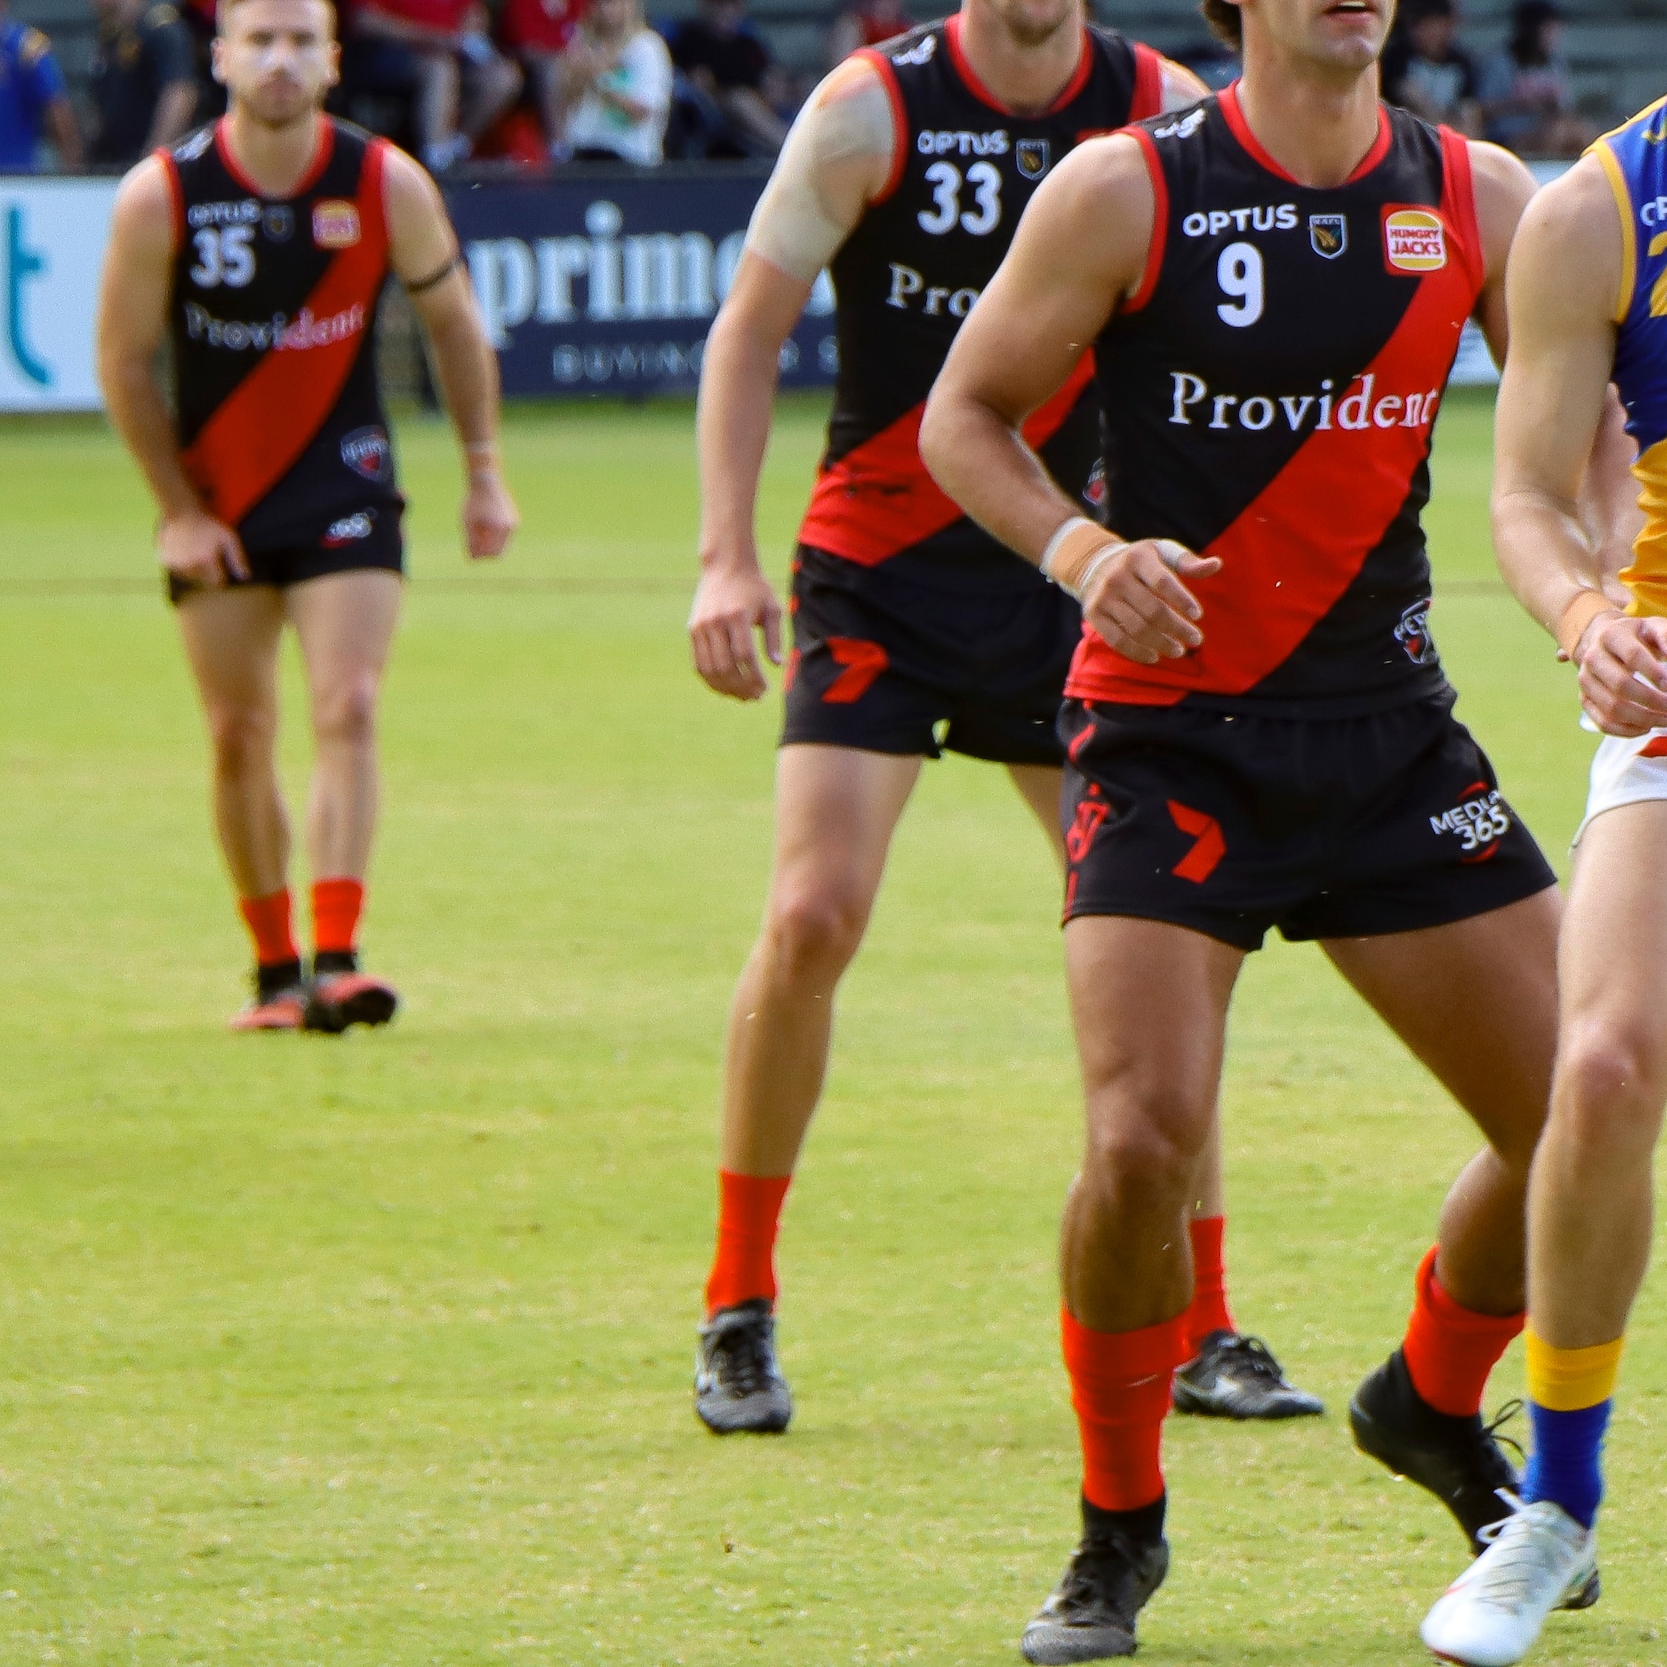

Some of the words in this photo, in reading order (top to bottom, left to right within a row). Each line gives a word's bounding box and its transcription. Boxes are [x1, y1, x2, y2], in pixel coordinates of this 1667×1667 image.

[917, 129, 1010, 156] OPTUS
[916, 160, 1003, 235] 33
[1182, 204, 1298, 237] OPTUS
[189, 225, 257, 288] 35
[1391, 241, 1441, 255] JACKS
[885, 261, 981, 318] Pro
[1216, 242, 1264, 328] 9
[1168, 372, 1439, 432] Provident
[1453, 805, 1511, 851] 365
